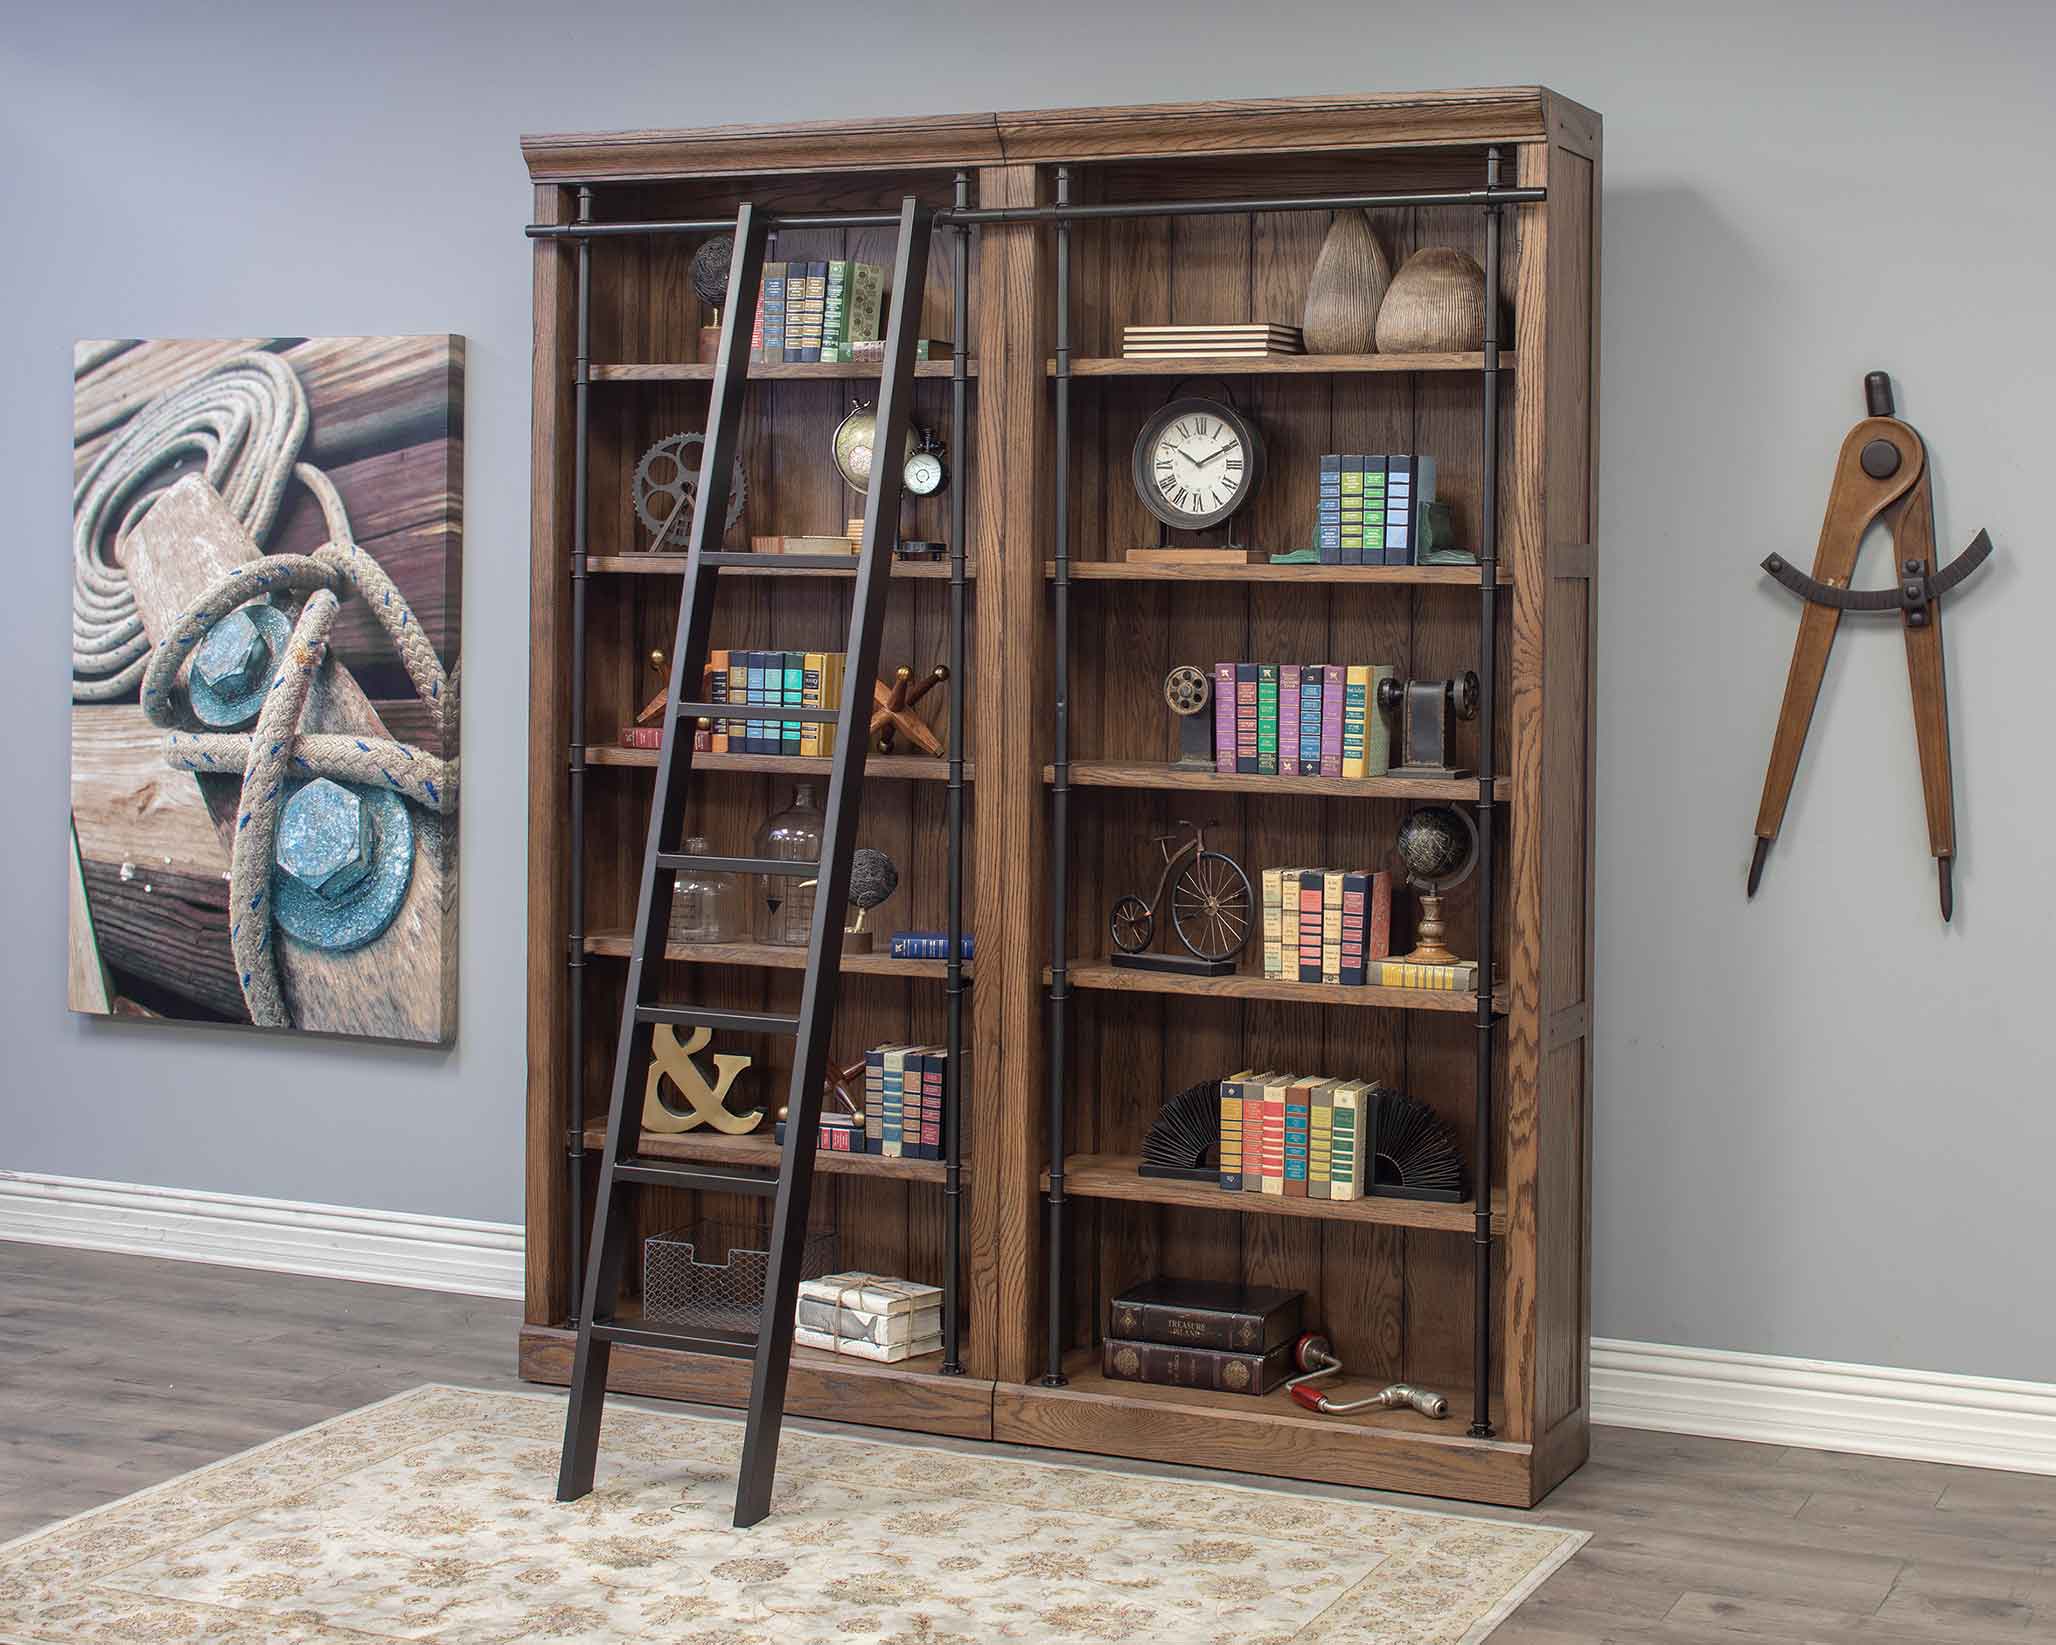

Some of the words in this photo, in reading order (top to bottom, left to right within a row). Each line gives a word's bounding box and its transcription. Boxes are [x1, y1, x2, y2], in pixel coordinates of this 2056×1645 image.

[1175, 421, 1191, 440] XI
[1193, 417, 1207, 436] XII
[1213, 423, 1224, 440] I
[1161, 440, 1178, 453] X
[1156, 459, 1173, 469] IX
[1226, 460, 1242, 470] III
[1159, 474, 1177, 494] VIII
[1172, 487, 1190, 508] VII
[1192, 493, 1205, 512] VI
[1211, 490, 1224, 509] V
[641, 1023, 763, 1135] &
